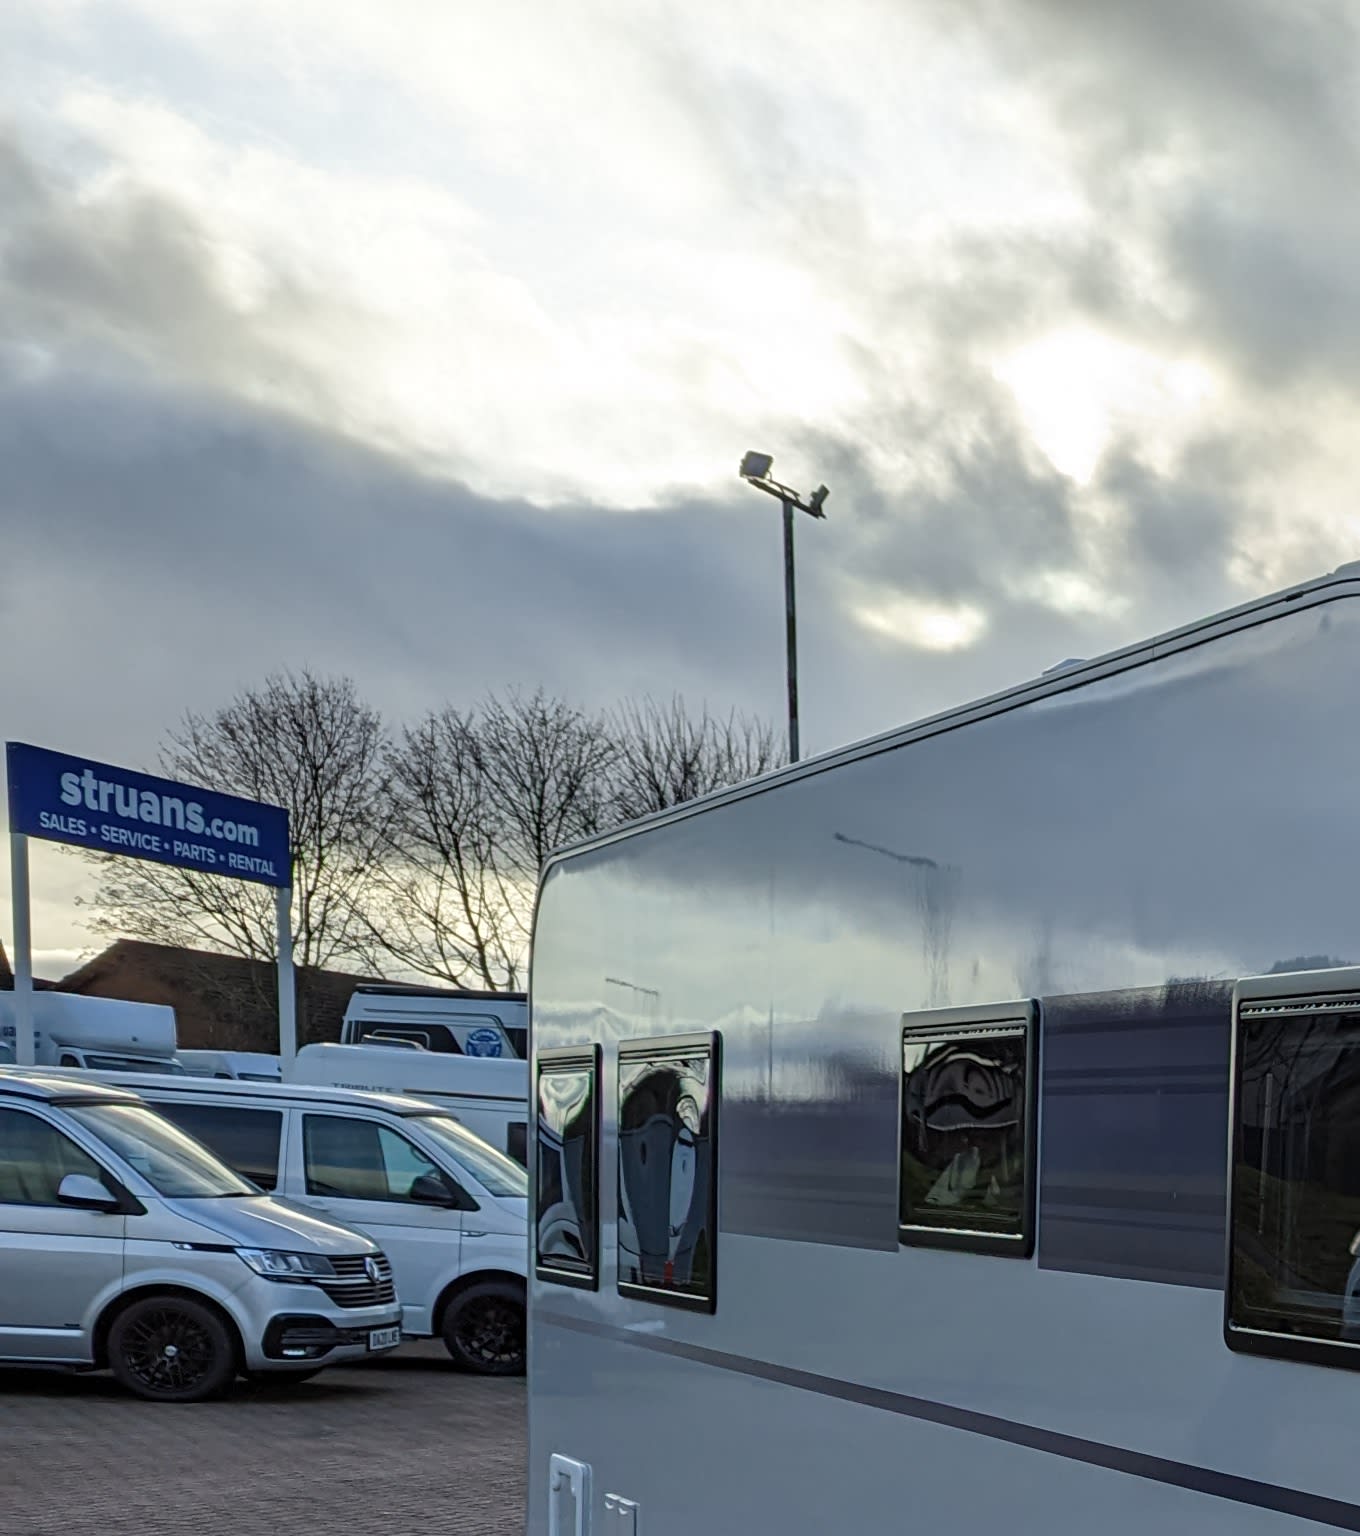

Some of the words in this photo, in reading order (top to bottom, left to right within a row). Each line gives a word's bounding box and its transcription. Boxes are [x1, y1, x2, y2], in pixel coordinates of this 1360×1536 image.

[40, 811, 87, 836] SALES
[101, 825, 161, 853] SERVICE
[173, 841, 216, 864] PARTS
[229, 853, 278, 877] RENTAL
[60, 769, 259, 847] struans.com
